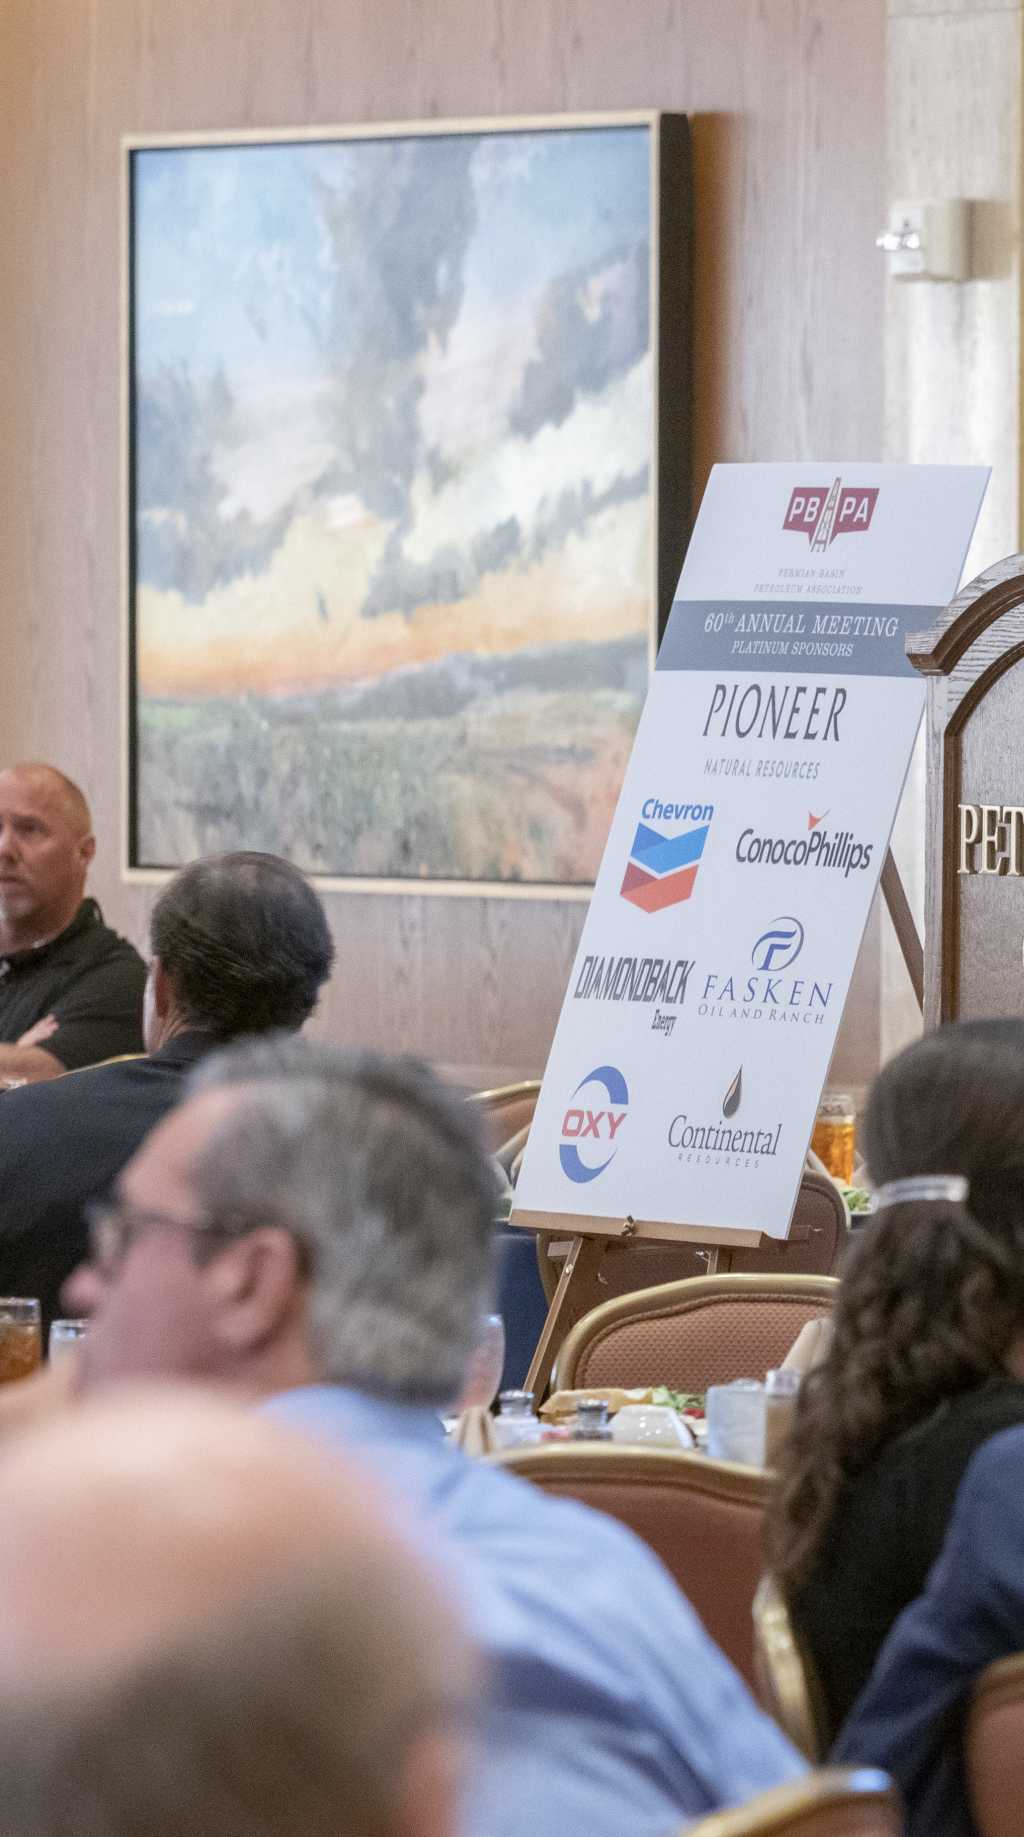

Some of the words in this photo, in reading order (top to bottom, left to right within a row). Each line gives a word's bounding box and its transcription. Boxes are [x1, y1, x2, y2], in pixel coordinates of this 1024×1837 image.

[788, 496, 821, 522] PB
[839, 496, 869, 522] PA
[704, 612, 735, 633] 60th
[734, 613, 806, 633] ANNUAL
[811, 615, 899, 637] MEETING
[731, 640, 788, 655] PLATINUM
[792, 641, 854, 657] SPONSORS
[702, 684, 847, 742] PIONEER
[703, 757, 751, 777] NATURAL
[755, 759, 820, 780] RESOURCES
[641, 798, 714, 821] Chevron
[735, 828, 874, 878] ConocoPhillips
[574, 955, 696, 1004] DIAMONDBACK
[701, 974, 833, 1008] FASKEN
[651, 1009, 678, 1037] Energy
[729, 1007, 762, 1020] AND
[768, 1008, 825, 1025] RANCH
[561, 1109, 628, 1140] OXY
[668, 1114, 783, 1156] Continental
[677, 1152, 760, 1169] RESOURCES
